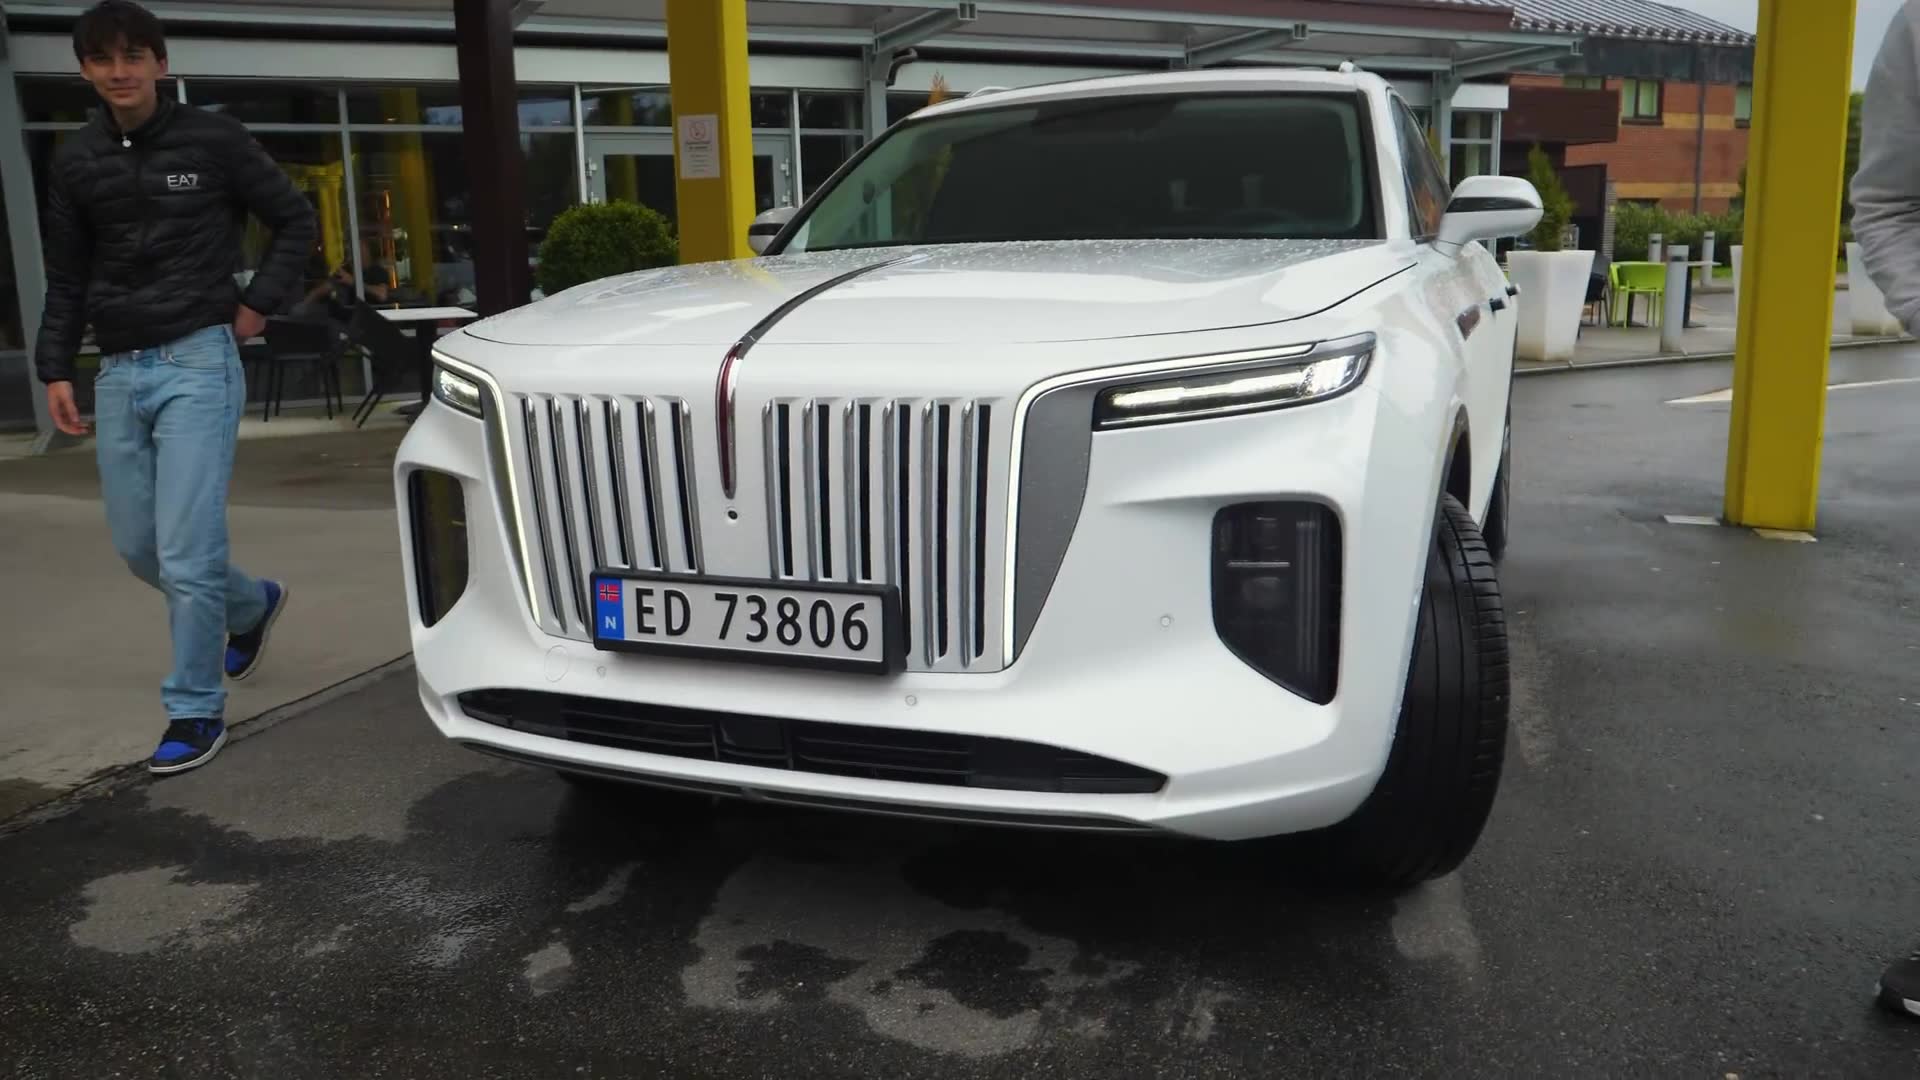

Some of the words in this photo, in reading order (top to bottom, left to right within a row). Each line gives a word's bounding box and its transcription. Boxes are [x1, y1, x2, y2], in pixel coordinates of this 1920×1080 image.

[167, 174, 198, 187] EA7
[604, 616, 616, 630] N
[635, 587, 691, 637] ED
[714, 592, 869, 651] 73806
